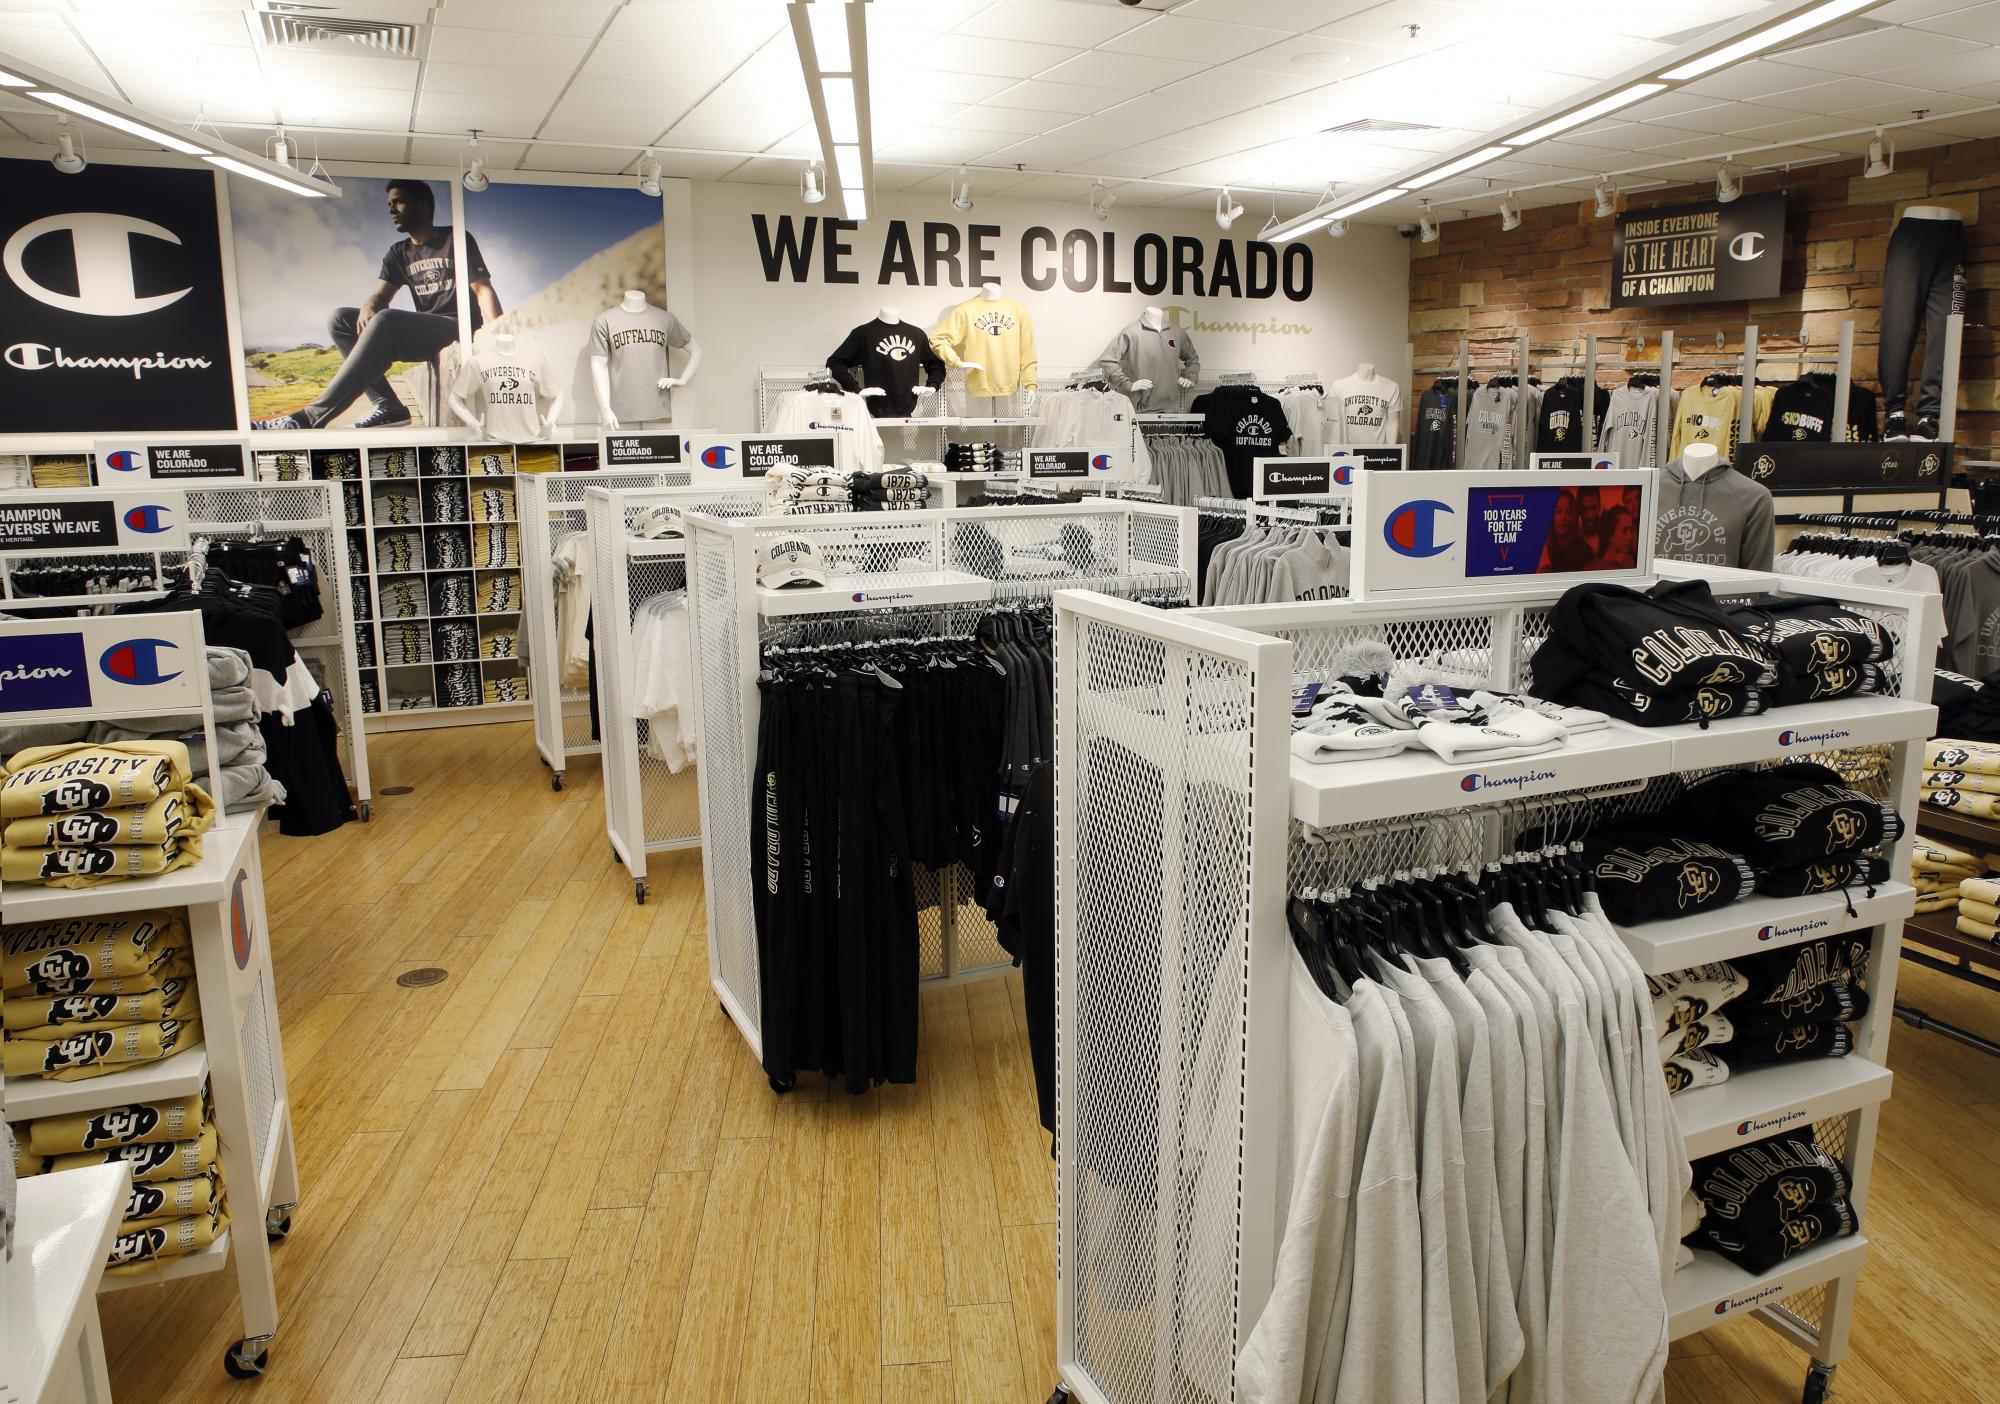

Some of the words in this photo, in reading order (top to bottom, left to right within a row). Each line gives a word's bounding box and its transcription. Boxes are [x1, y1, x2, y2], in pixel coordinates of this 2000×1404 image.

[1625, 219, 1661, 238] INSIDE
[1663, 211, 1720, 233] EVERYONE
[752, 213, 859, 285] WE
[877, 219, 1001, 289] ARE
[1020, 226, 1314, 302] COLORADO
[1623, 244, 1637, 273] IS
[1642, 241, 1667, 271] THE
[1672, 235, 1718, 269] HEART
[1621, 280, 1637, 297] OF
[1638, 279, 1647, 295] A
[1650, 273, 1715, 296] CHAMPION
[974, 311, 1015, 331] COLORADO
[612, 329, 667, 349] BUFFALOES
[876, 334, 916, 356] COLORADO
[4, 342, 212, 379] Champion
[481, 366, 526, 384] UNIVERSITY
[489, 392, 533, 405] OLORADO
[1344, 395, 1380, 407] UNIVERSITY
[1235, 415, 1273, 435] COLORADO
[612, 440, 624, 448] WE
[625, 440, 640, 448] ARE
[749, 445, 763, 455] WE
[766, 444, 784, 454] ARE
[155, 450, 171, 459] WE
[173, 449, 191, 459] ARE
[612, 447, 652, 456] COLORADO
[156, 459, 207, 469] COLORADO
[750, 455, 799, 466] COLORADO
[1034, 455, 1045, 463] WE
[1046, 455, 1057, 463] ARE
[1034, 462, 1067, 470] COLORADO
[1553, 461, 1563, 469] ARE
[887, 475, 911, 488] 1876
[1269, 471, 1325, 486] Champion
[892, 488, 916, 501] 1876
[651, 506, 681, 520] COLORADO
[1483, 509, 1498, 521] 100
[1500, 509, 1527, 521] YEARS
[54, 520, 101, 534] WEAVE
[1488, 521, 1504, 532] FOR
[1506, 521, 1523, 532] THE
[1655, 505, 1719, 544] UNIVERSITY
[1713, 526, 1726, 545] OF
[1493, 532, 1517, 544] TEAM
[770, 541, 811, 560] COLORADO
[1654, 553, 1726, 566] OLORADO
[852, 592, 913, 604] Champion
[1778, 727, 1851, 747] Champion
[7, 756, 148, 788] IVERSITY
[1461, 769, 1557, 793] Champion
[1758, 918, 1829, 941] Champion
[1736, 1108, 1808, 1136] Champion
[1714, 1283, 1784, 1315] Champion
